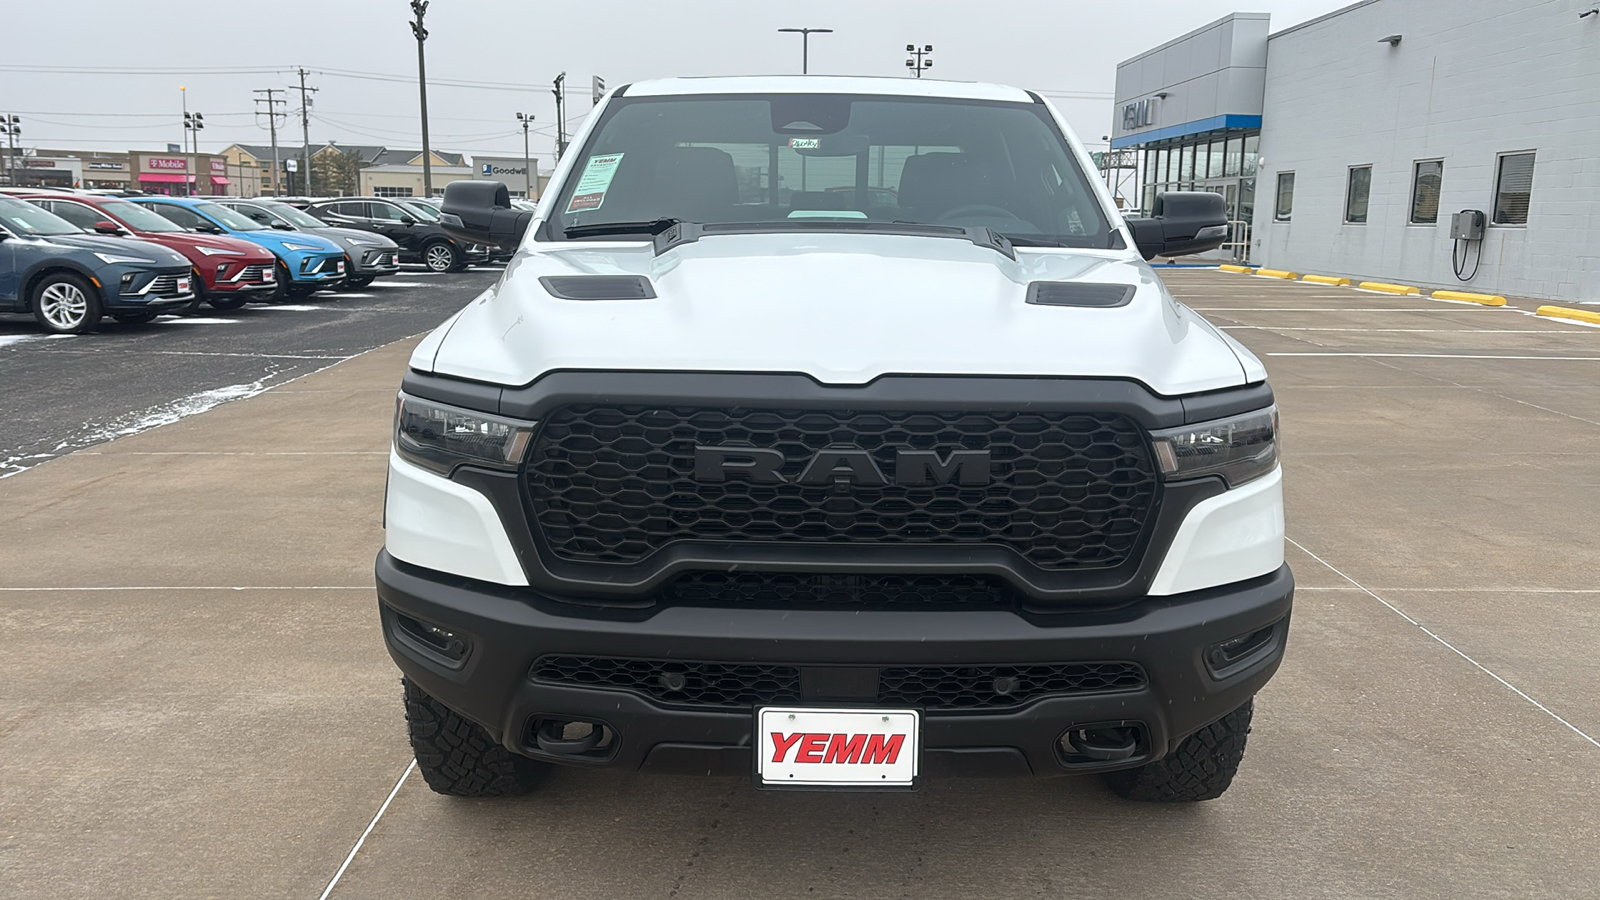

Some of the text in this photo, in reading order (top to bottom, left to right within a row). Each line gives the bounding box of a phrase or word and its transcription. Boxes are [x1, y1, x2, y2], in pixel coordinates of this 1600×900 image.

[492, 166, 527, 175] Goodwil
[695, 445, 991, 485] RAM
[770, 732, 906, 764] YEMM
